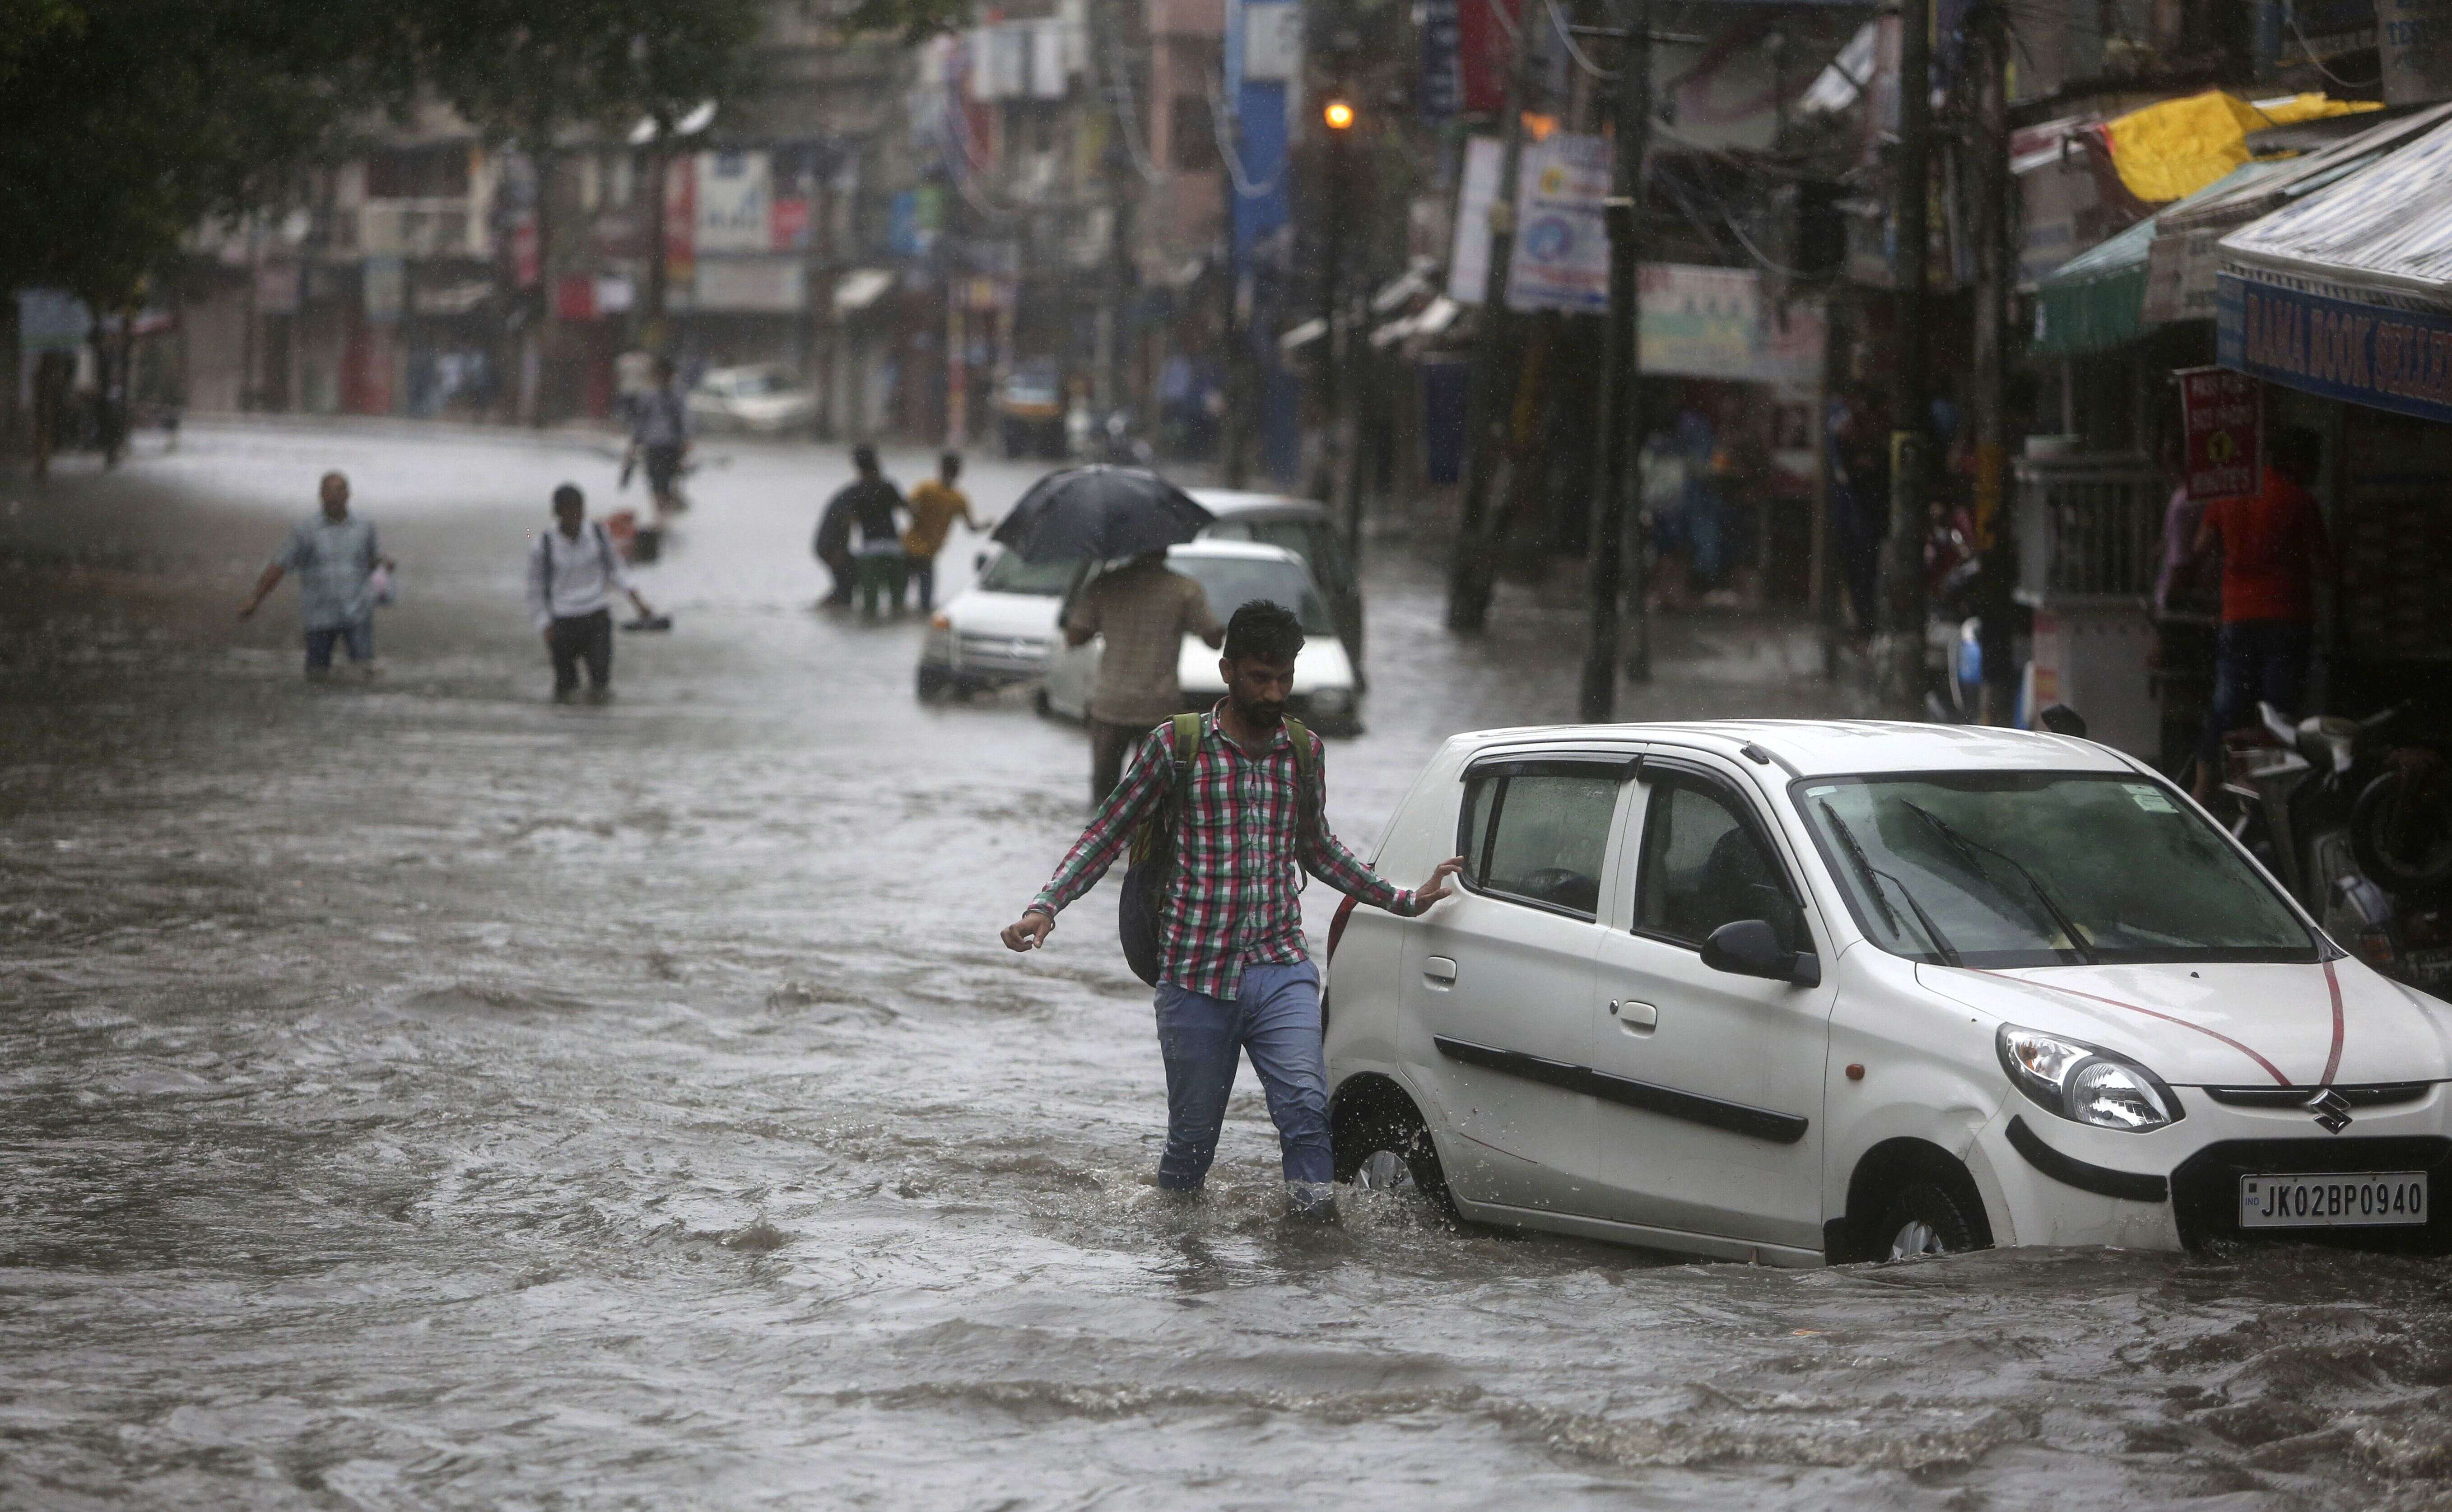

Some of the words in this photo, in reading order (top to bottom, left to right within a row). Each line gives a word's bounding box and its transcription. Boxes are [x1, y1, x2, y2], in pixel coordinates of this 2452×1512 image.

[2309, 308, 2371, 389] BOOK
[2245, 1197, 2259, 1206] IND
[2261, 1183, 2421, 1217] JK02BP0940
